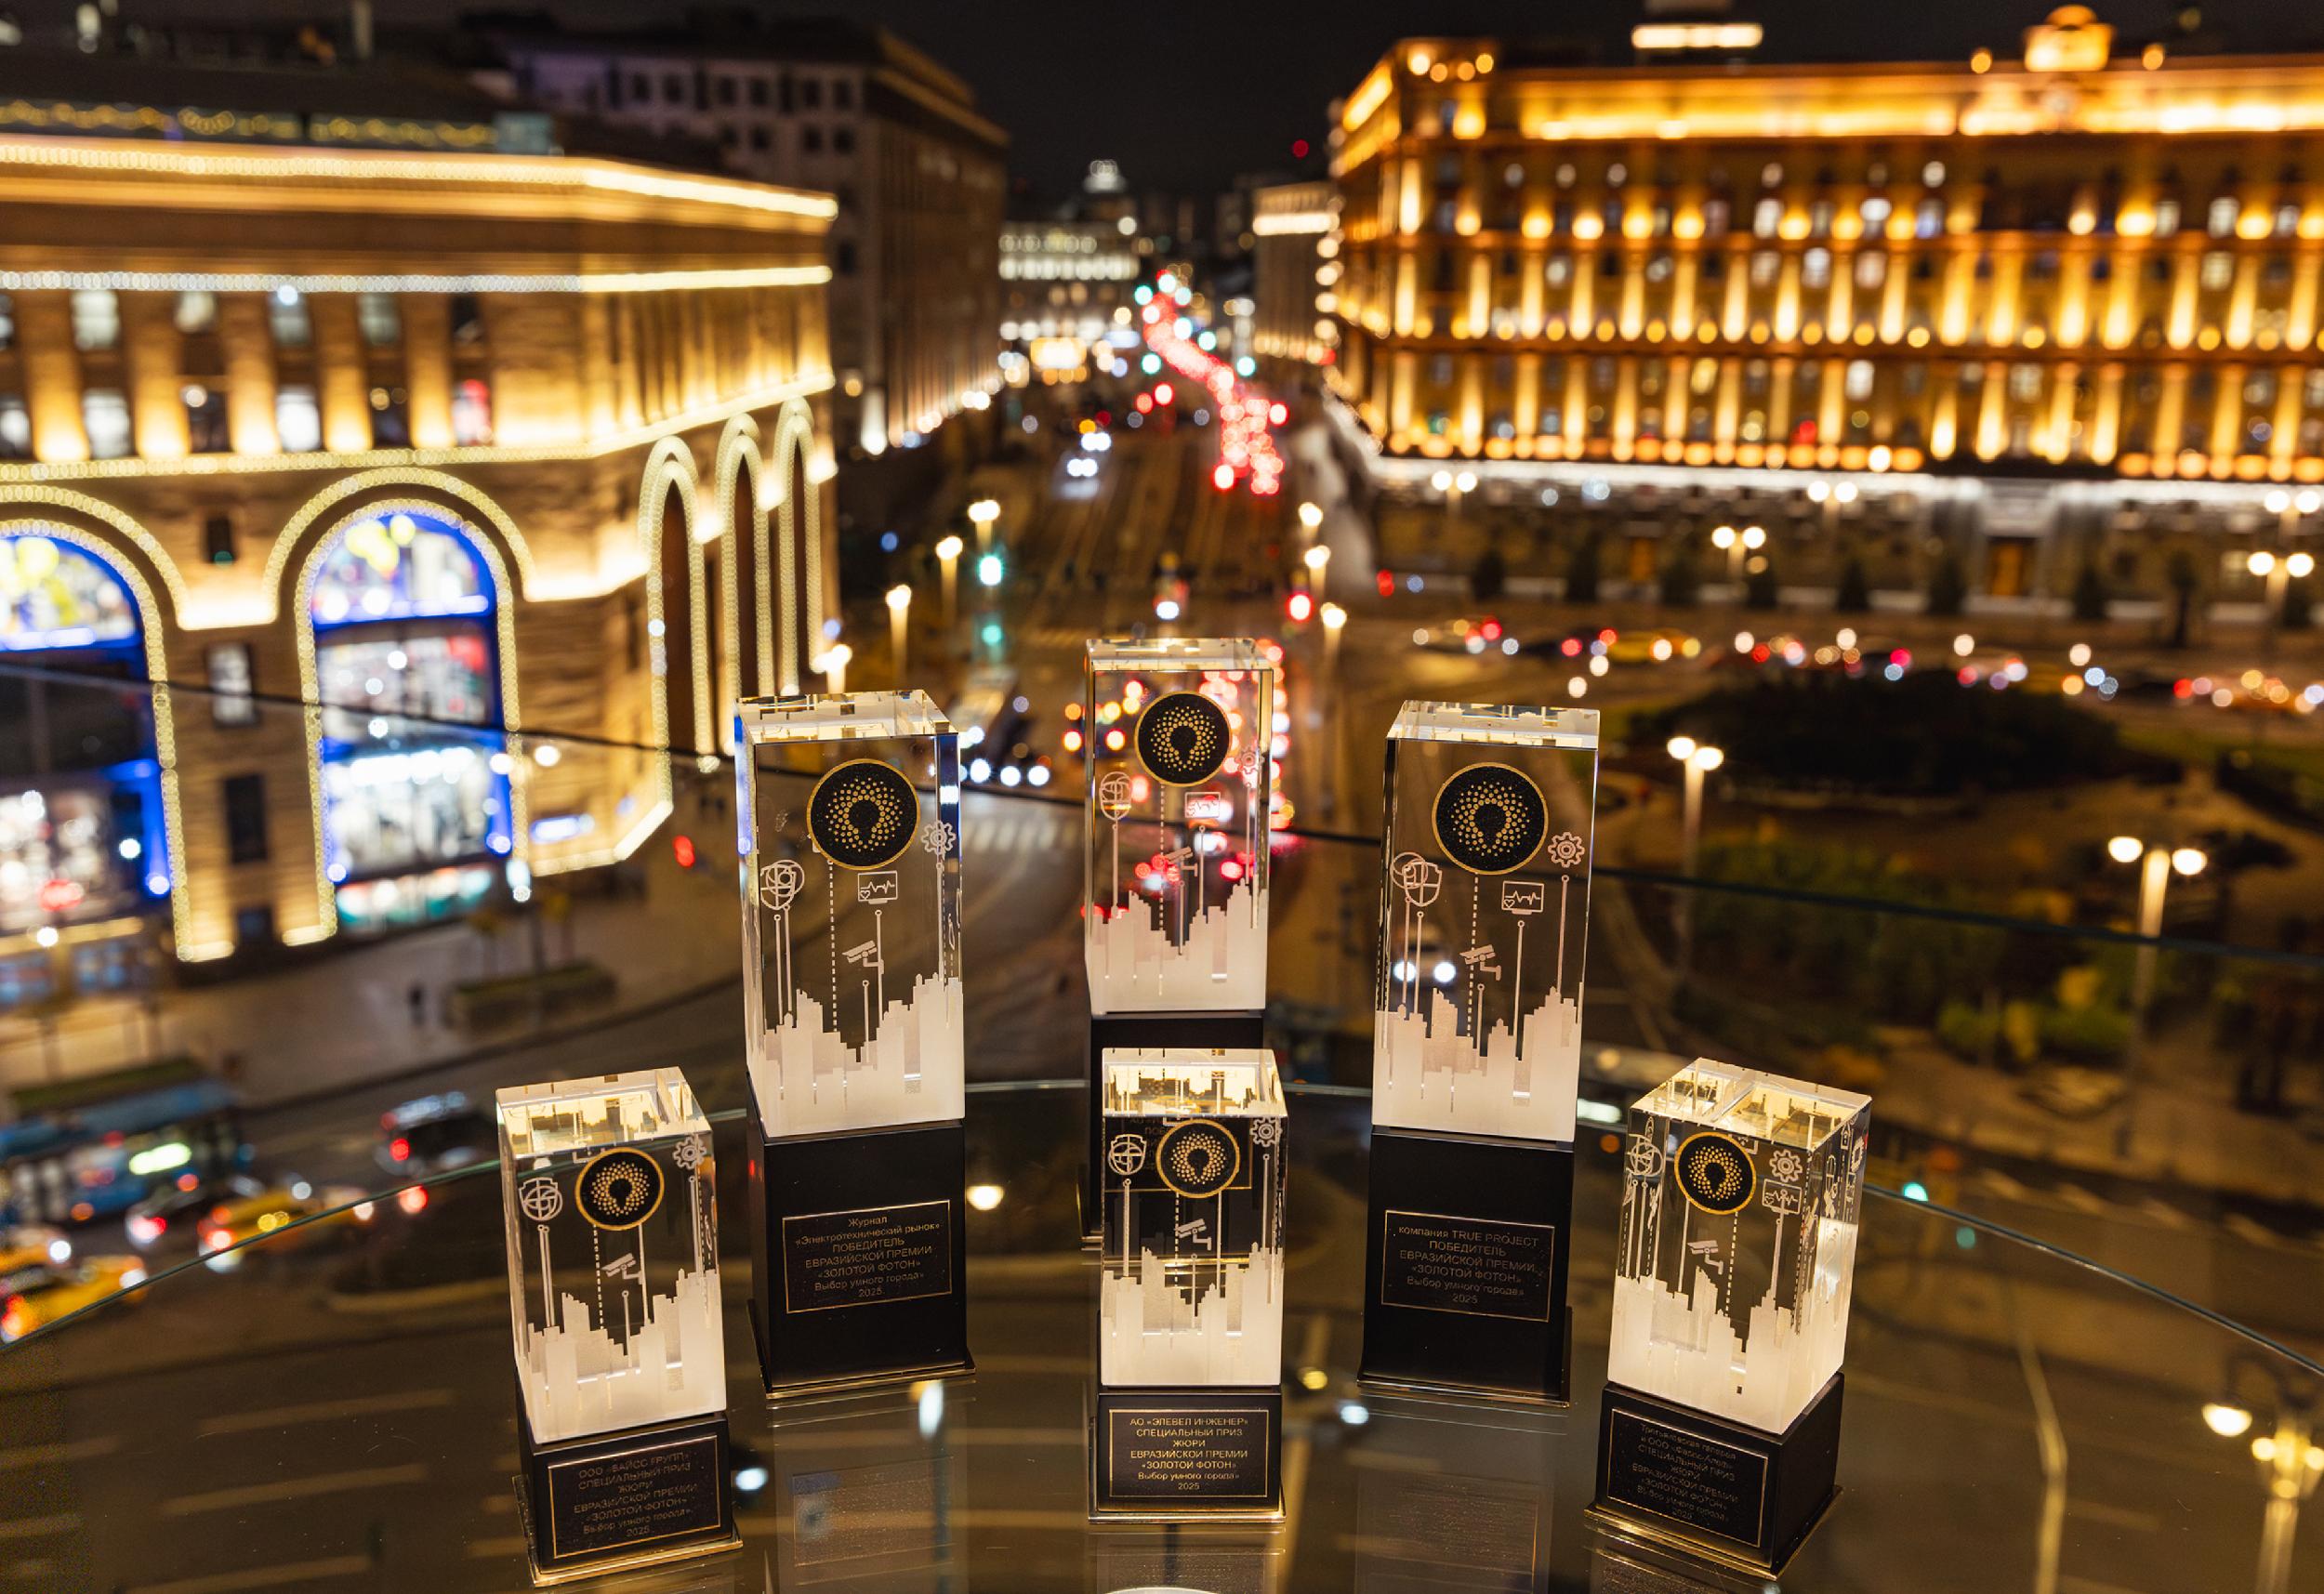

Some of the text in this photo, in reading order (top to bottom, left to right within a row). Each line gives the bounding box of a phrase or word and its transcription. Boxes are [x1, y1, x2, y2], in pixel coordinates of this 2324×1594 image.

[848, 1215, 887, 1228] Журнал
[905, 1221, 939, 1233] рынок»
[1398, 1226, 1538, 1247] компания TRUE PROJECT
[832, 1236, 905, 1253] ПОБЕДИТЕЛЬ
[1429, 1240, 1506, 1257] ПОБЕДИТЕЛЬ
[805, 1245, 931, 1268] ЕВРАЗИЙСКОЙ ПРЕМИИ
[1399, 1248, 1534, 1271] ЕВРАЗИЙСКОЙ ПРЕМИИ
[878, 1258, 920, 1271] ФОТОН»
[814, 1279, 847, 1292] Выбор
[850, 1275, 883, 1288] умного
[1474, 1270, 1521, 1283] ФОТОН»
[1406, 1276, 1441, 1287] Выбор
[1444, 1281, 1480, 1293] умного
[1452, 1293, 1477, 1303] 2025
[578, 1466, 602, 1479] ООО
[663, 1461, 690, 1475] ПРИЗ
